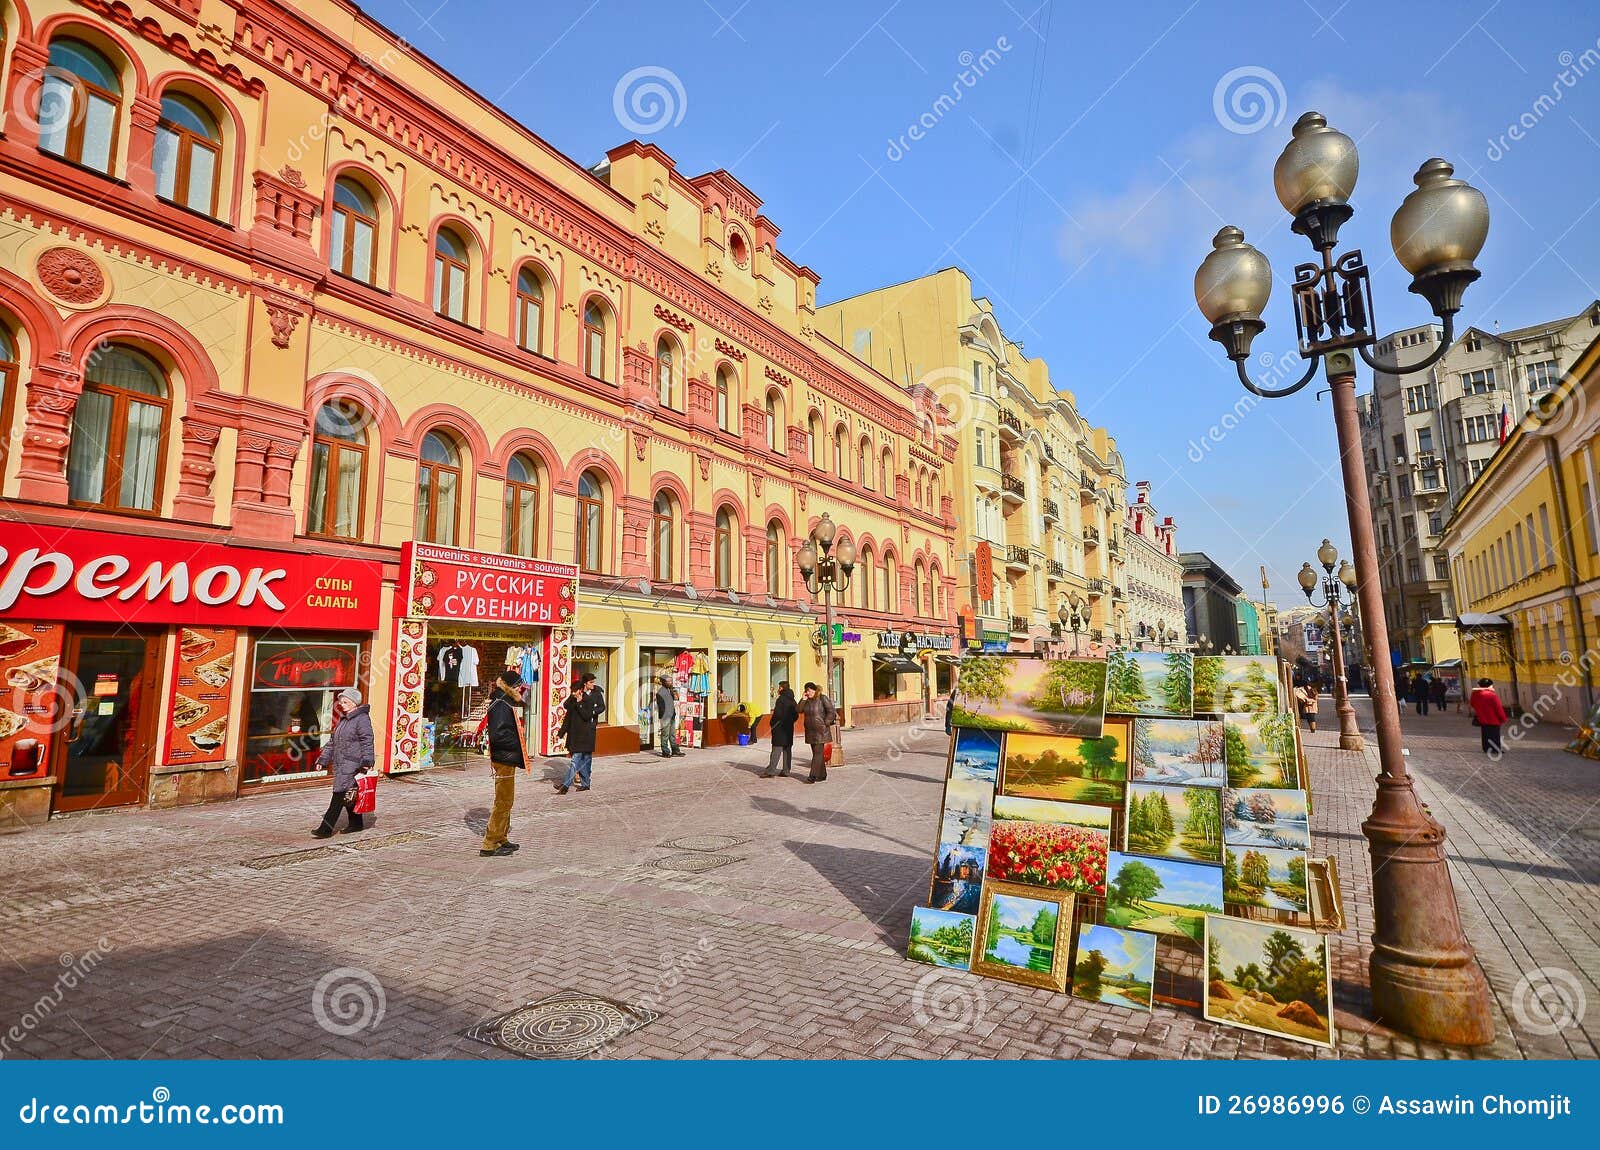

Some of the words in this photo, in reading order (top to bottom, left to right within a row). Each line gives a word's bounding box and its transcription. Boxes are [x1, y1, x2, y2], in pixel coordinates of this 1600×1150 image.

[417, 547, 471, 562] souvenirs
[480, 555, 527, 569] souvenirs
[534, 563, 575, 576] souvenirs
[0, 545, 287, 611] ремок
[315, 577, 353, 591] СУПЫ
[456, 570, 545, 597] РУССКИЕ
[306, 594, 359, 609] САЛАТЫ
[444, 595, 552, 621] СУВЕНИРЫ
